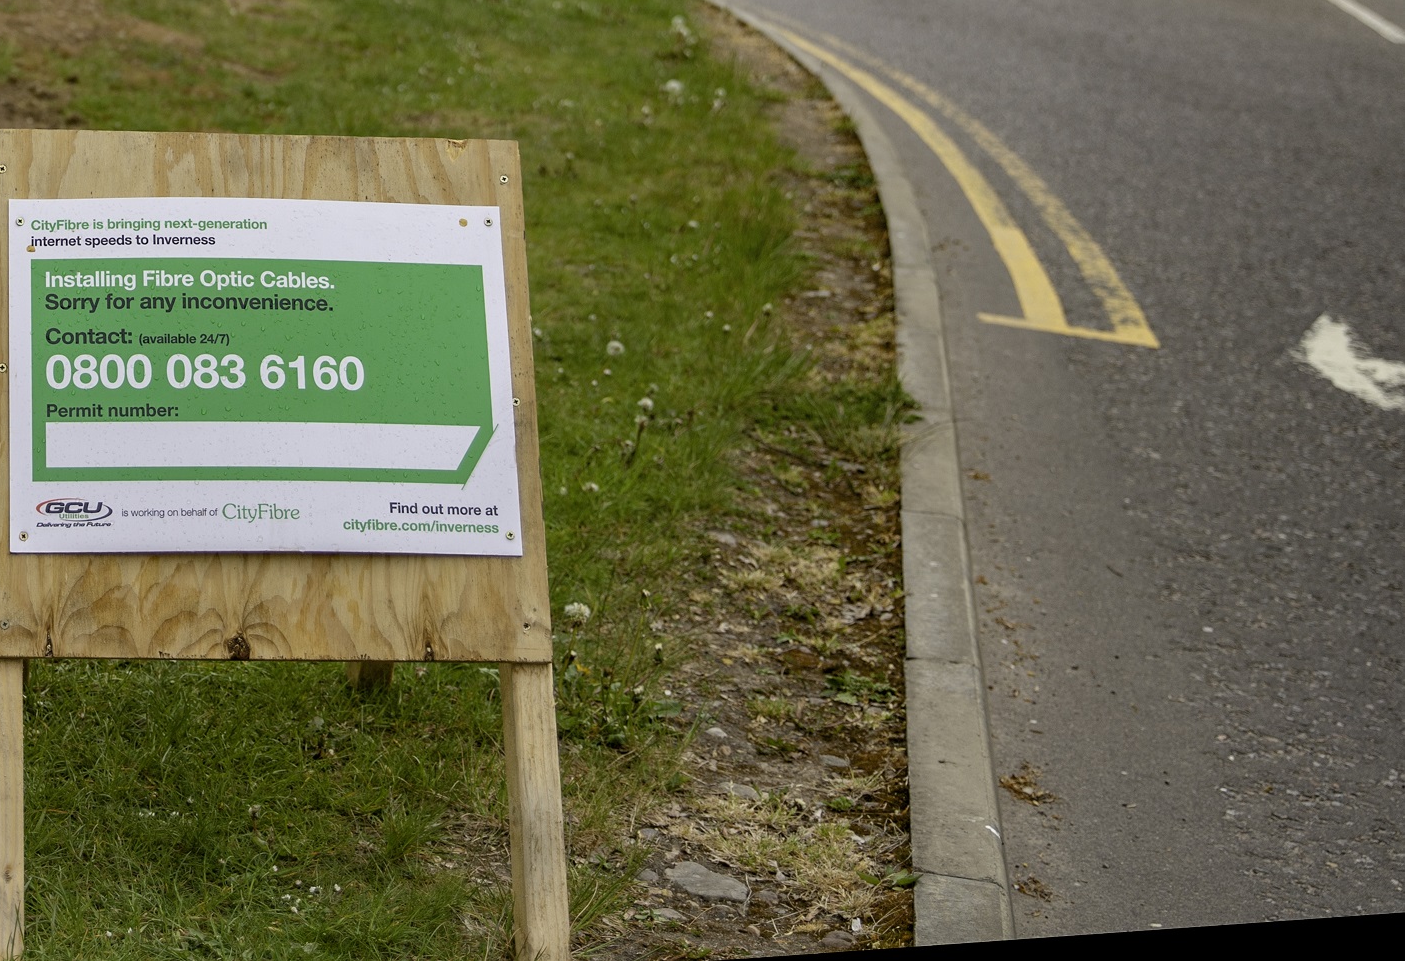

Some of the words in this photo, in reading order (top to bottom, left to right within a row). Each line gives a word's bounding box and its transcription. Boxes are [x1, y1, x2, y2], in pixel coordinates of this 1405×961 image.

[31, 219, 90, 234] CityFibre
[93, 219, 104, 230] is
[107, 218, 161, 233] bringing
[164, 218, 268, 232] next-generation
[31, 235, 81, 246] internet
[85, 235, 132, 247] speeds
[136, 236, 149, 245] to
[153, 234, 216, 246] Inverness
[45, 270, 137, 291] Installing
[143, 270, 195, 287] Fibre
[199, 270, 255, 290] Optic
[260, 271, 335, 289] Cables.
[45, 293, 100, 313] Sorry
[105, 293, 135, 310] for
[140, 295, 176, 312] any
[182, 293, 334, 312] inconvenience.
[45, 327, 133, 345] Contact:
[139, 333, 196, 346] (available
[199, 333, 230, 346] 24/7)
[45, 353, 153, 389] 0800
[166, 353, 246, 389] 083
[260, 354, 365, 391] 6160
[46, 404, 103, 418] Permit
[108, 404, 179, 418] number:
[45, 502, 103, 514] GCU
[121, 508, 128, 517] is
[130, 508, 165, 519] working
[180, 507, 207, 517] behalf
[209, 507, 219, 517] of
[222, 503, 300, 523] CityFibre
[389, 502, 418, 514] Find
[422, 504, 444, 515] out
[447, 505, 481, 516] more
[485, 505, 499, 516] at
[343, 519, 500, 534] cityfibre.com/inverness
